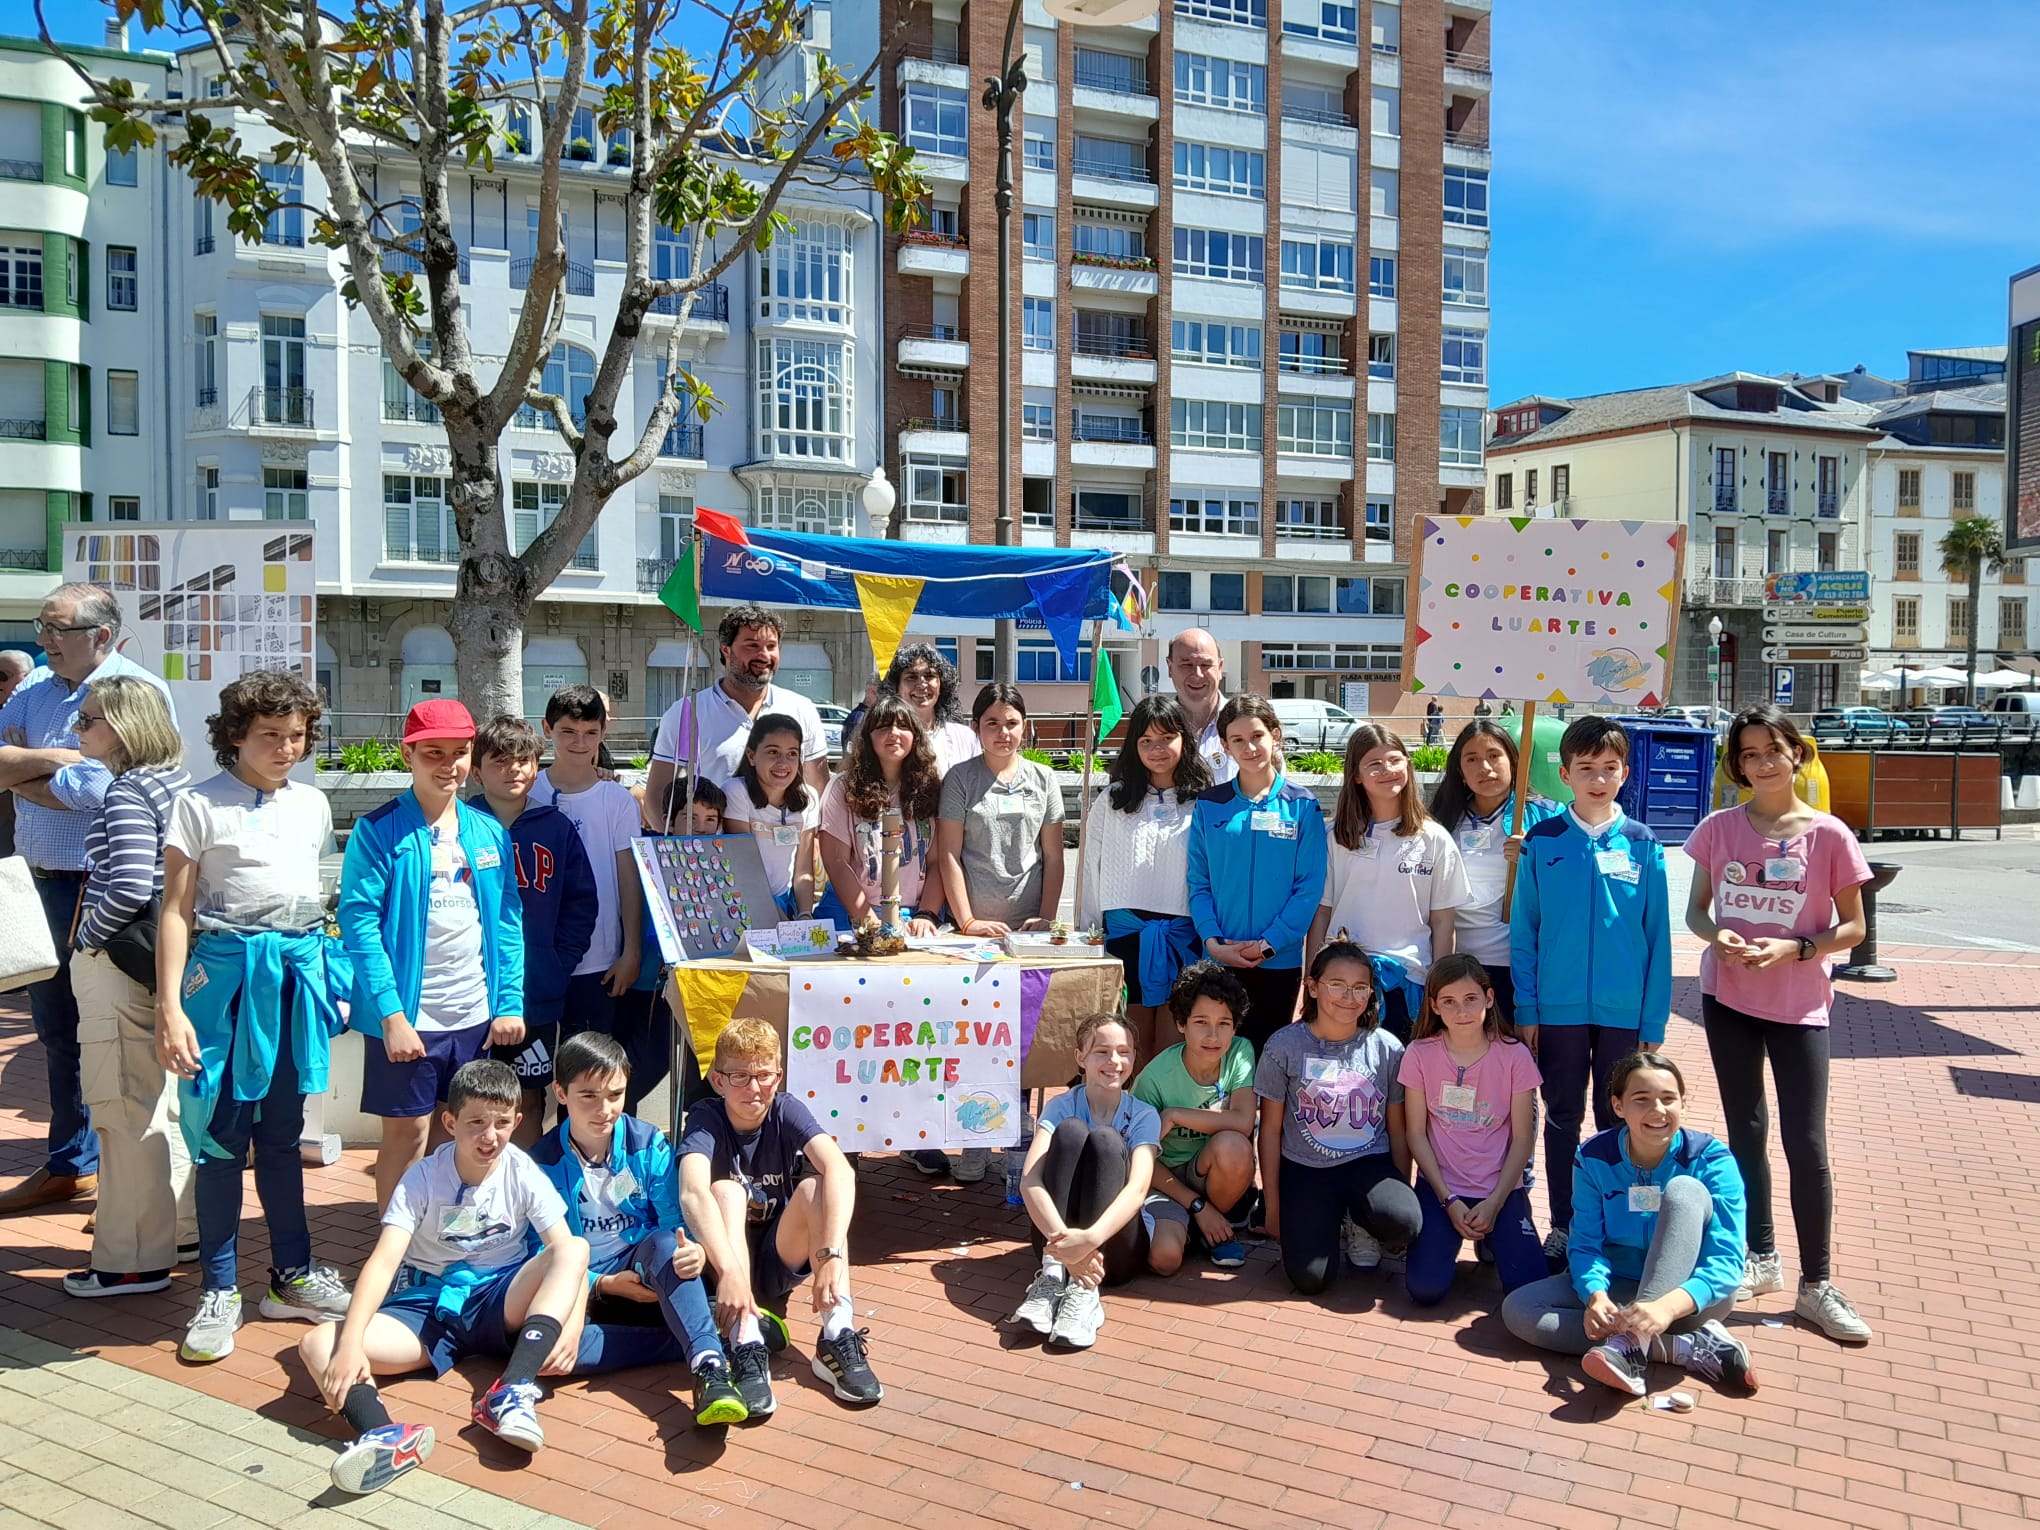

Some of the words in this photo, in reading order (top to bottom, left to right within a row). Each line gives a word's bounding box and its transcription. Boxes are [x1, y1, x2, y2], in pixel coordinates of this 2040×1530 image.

[1444, 583, 1632, 607] COOPERATIVA
[1491, 617, 1597, 636] LUARTE
[1785, 630, 1804, 638] Casa
[1830, 649, 1862, 658] Playas
[1777, 669, 1791, 690] P
[511, 842, 554, 893] AP
[430, 896, 476, 909] otorsp
[792, 1021, 1012, 1050] COOPERATIVA
[510, 1061, 553, 1077] adidas
[836, 1057, 961, 1084] LUARTE
[1300, 1128, 1343, 1159] HIGHWAY
